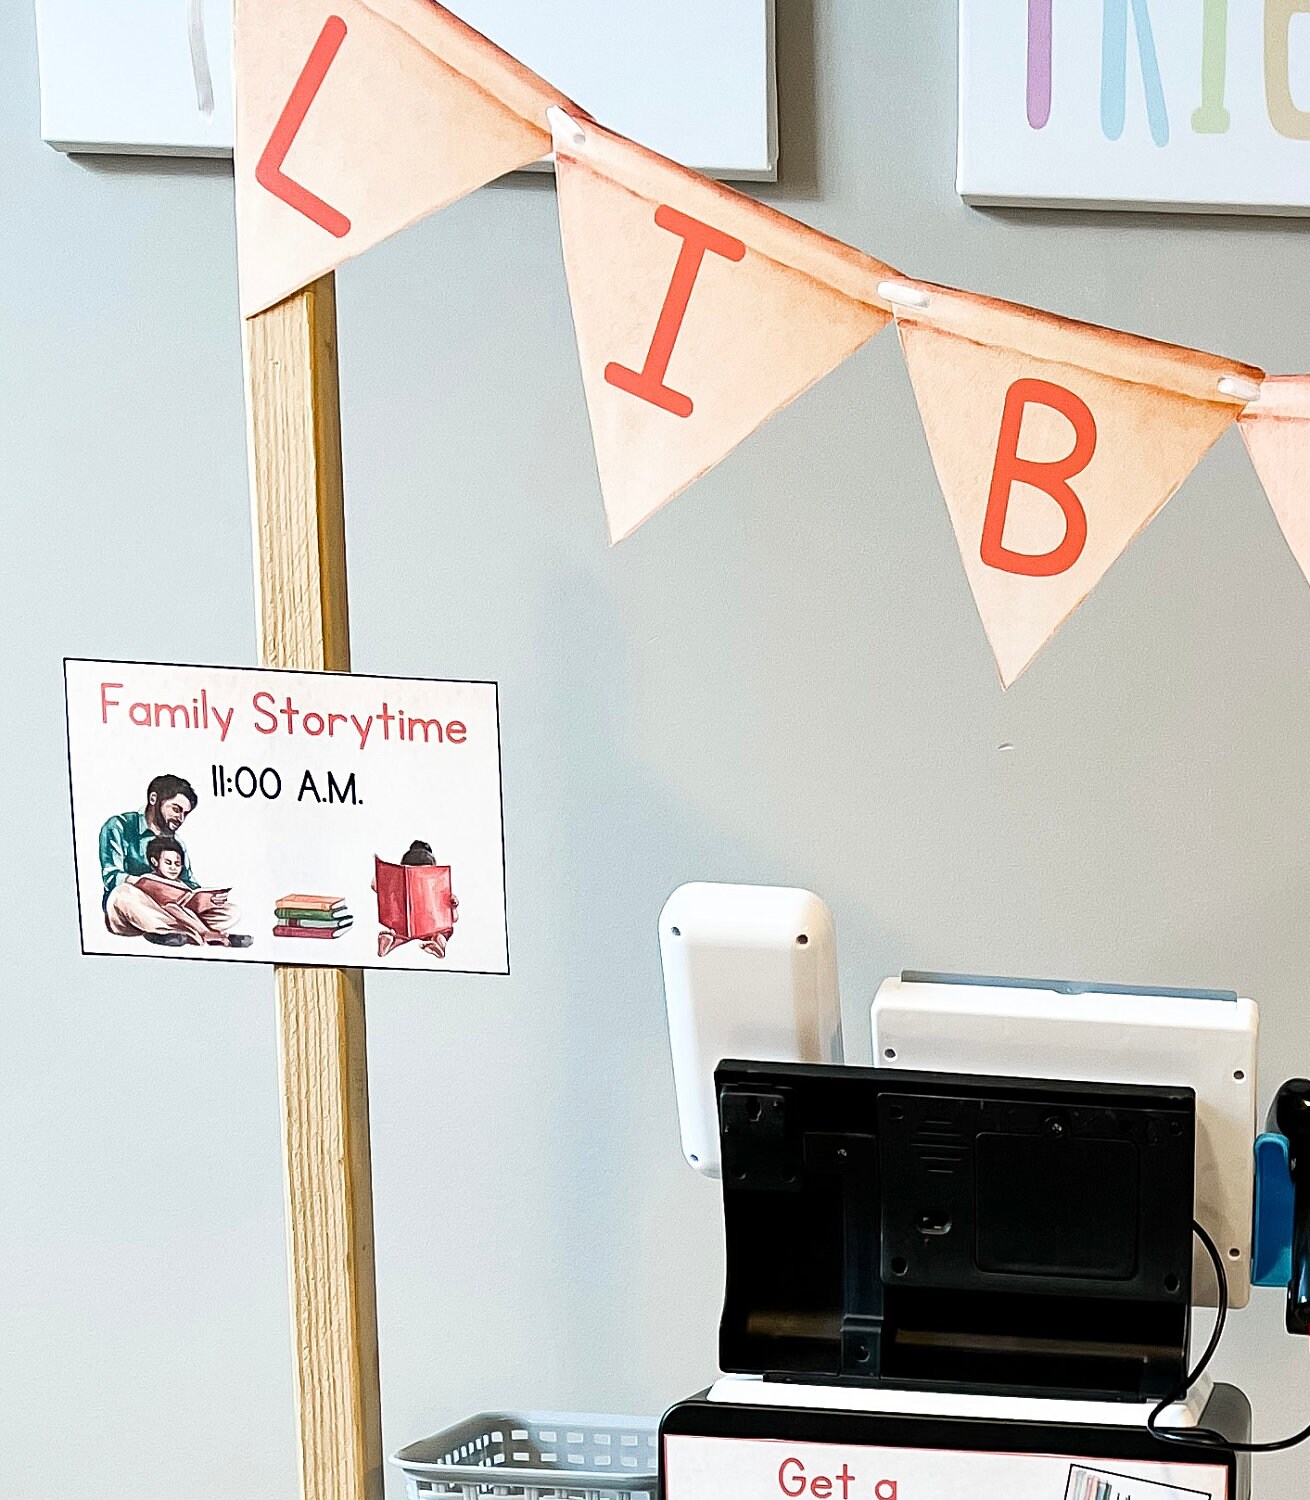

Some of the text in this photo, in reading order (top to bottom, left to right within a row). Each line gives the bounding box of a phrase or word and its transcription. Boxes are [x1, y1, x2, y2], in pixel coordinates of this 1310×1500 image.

[100, 682, 468, 750] Family Storytime
[211, 764, 363, 805] 11:00 A.M.
